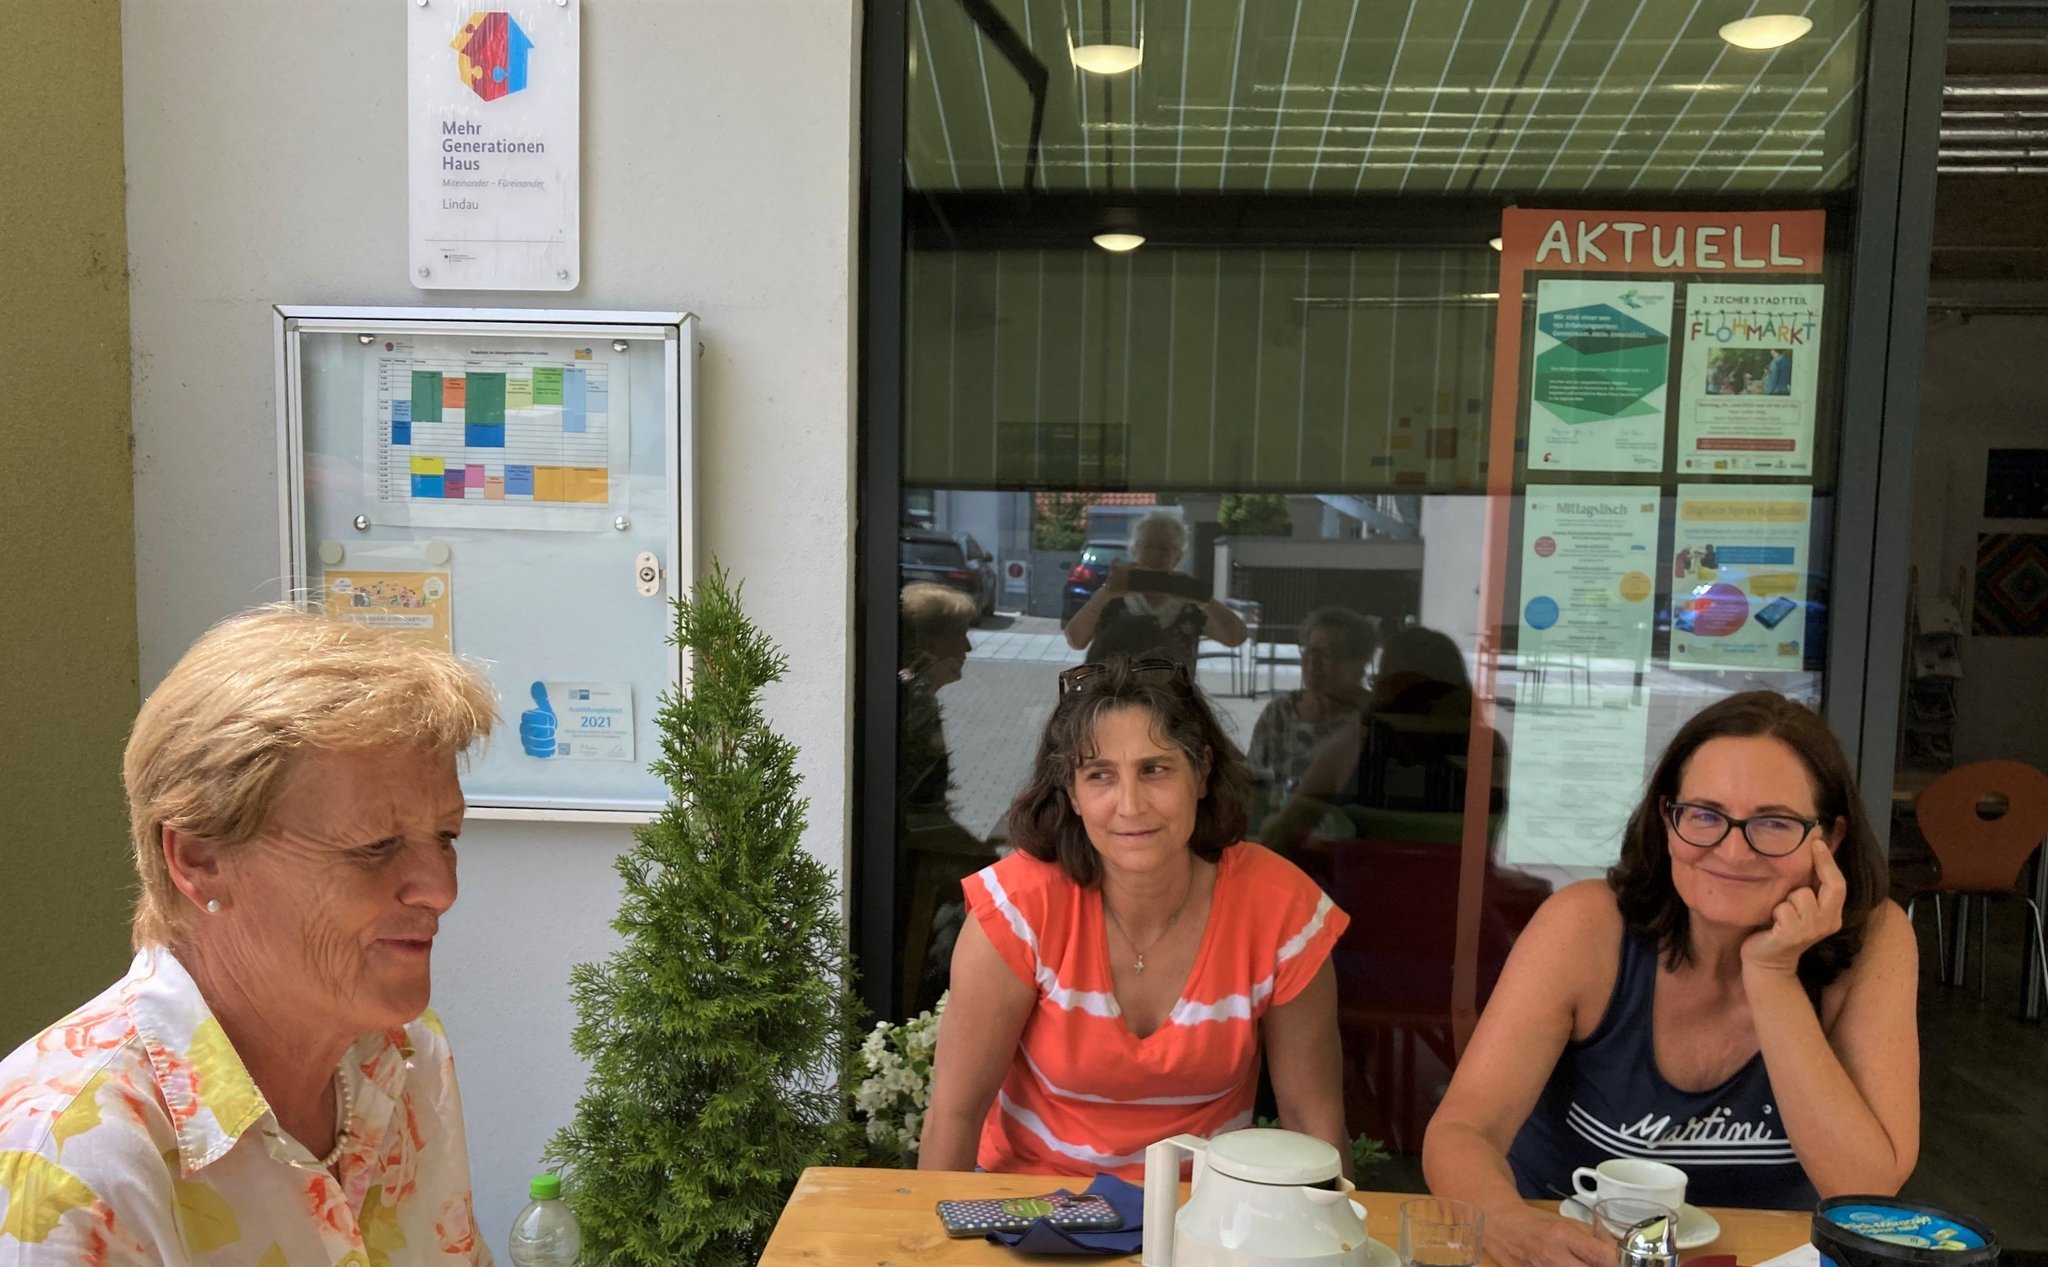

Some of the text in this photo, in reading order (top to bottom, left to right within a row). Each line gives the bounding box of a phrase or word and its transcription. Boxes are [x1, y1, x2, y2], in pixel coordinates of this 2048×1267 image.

[442, 120, 482, 135] Mehr
[442, 138, 545, 153] Generationen
[442, 156, 480, 170] Haus
[442, 179, 489, 188] Miteinander
[497, 178, 544, 189] Füreinander
[442, 198, 479, 210] Lindau
[1535, 219, 1804, 269] AKTUELL
[1713, 296, 1750, 304] ZECHER
[1753, 296, 1808, 305] STADTTEIL
[1691, 319, 1816, 345] FLOHMARKT
[1556, 502, 1628, 517] Mittagstisch
[581, 716, 612, 728] 2021
[1620, 1104, 1772, 1149] Martini
